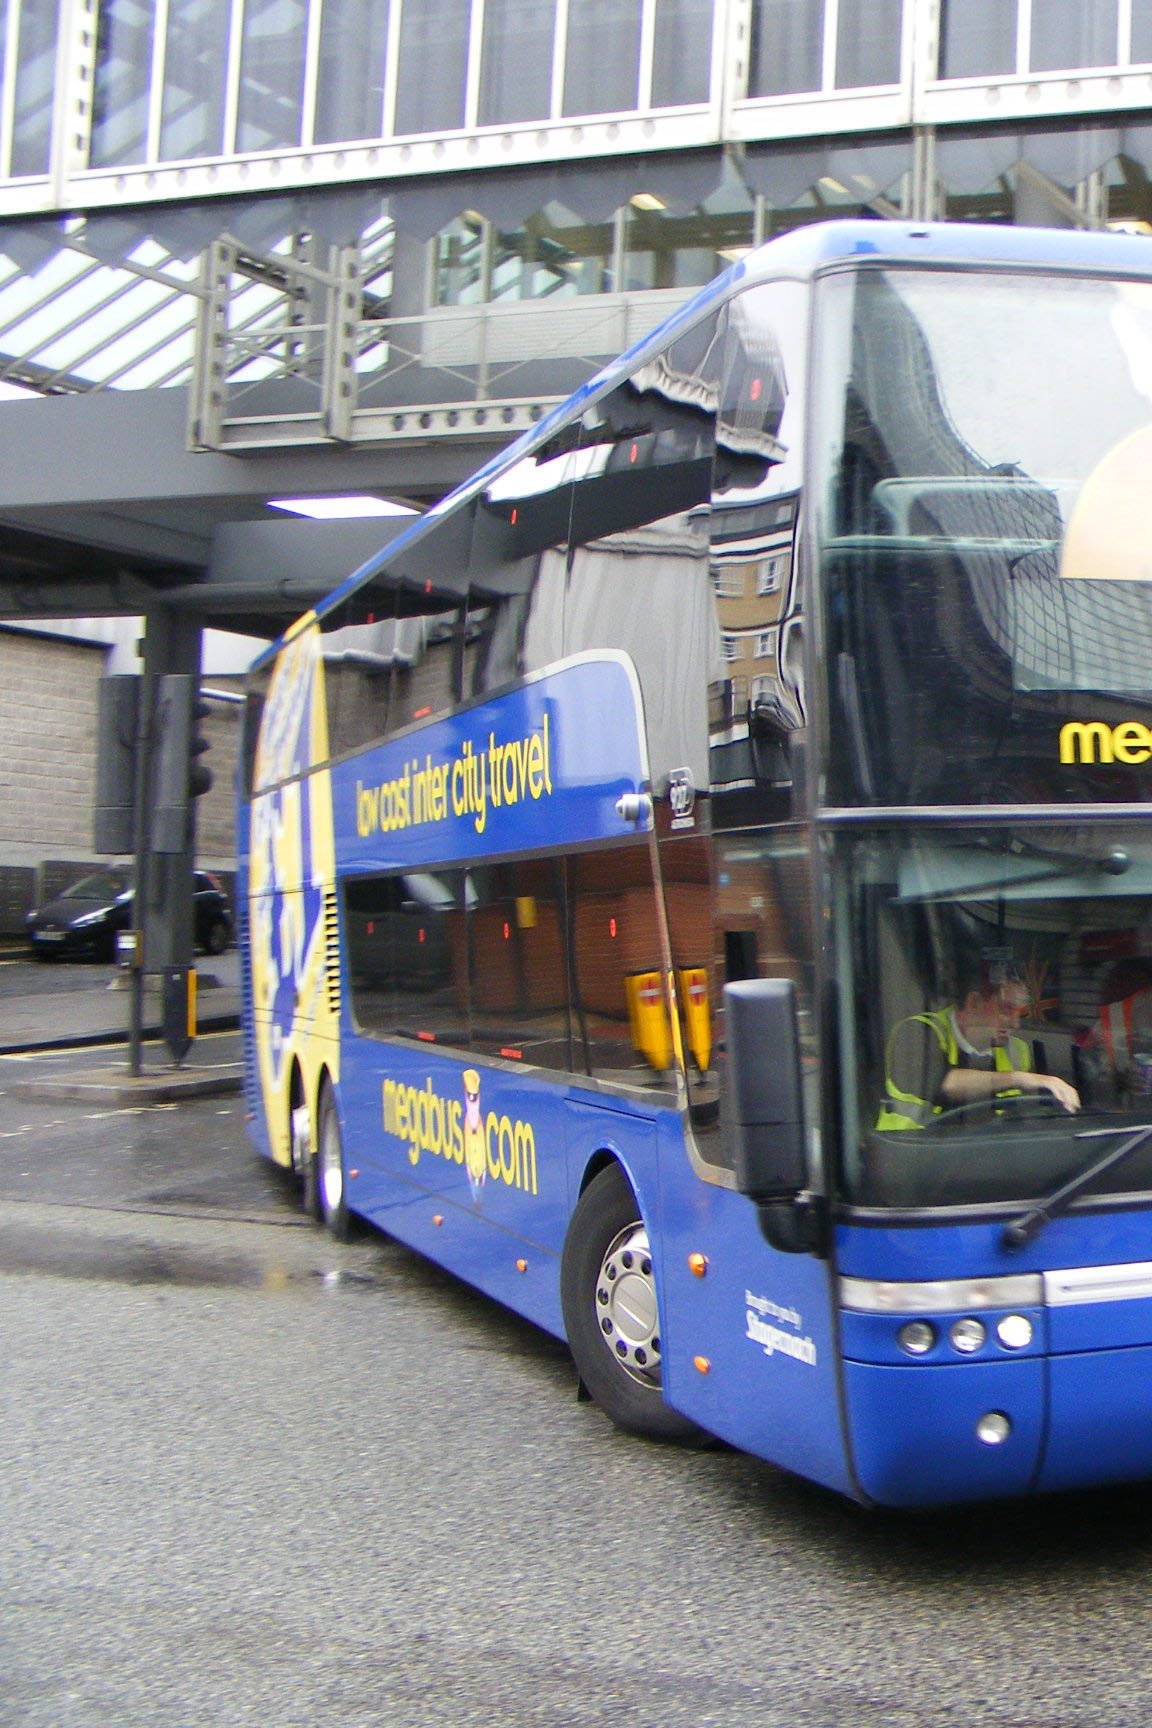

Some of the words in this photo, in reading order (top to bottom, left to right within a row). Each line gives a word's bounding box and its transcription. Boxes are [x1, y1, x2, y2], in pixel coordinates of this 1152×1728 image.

[356, 780, 380, 837] low
[379, 762, 411, 832] cost
[412, 754, 449, 825] inter
[452, 740, 486, 834] city
[488, 713, 552, 808] travel
